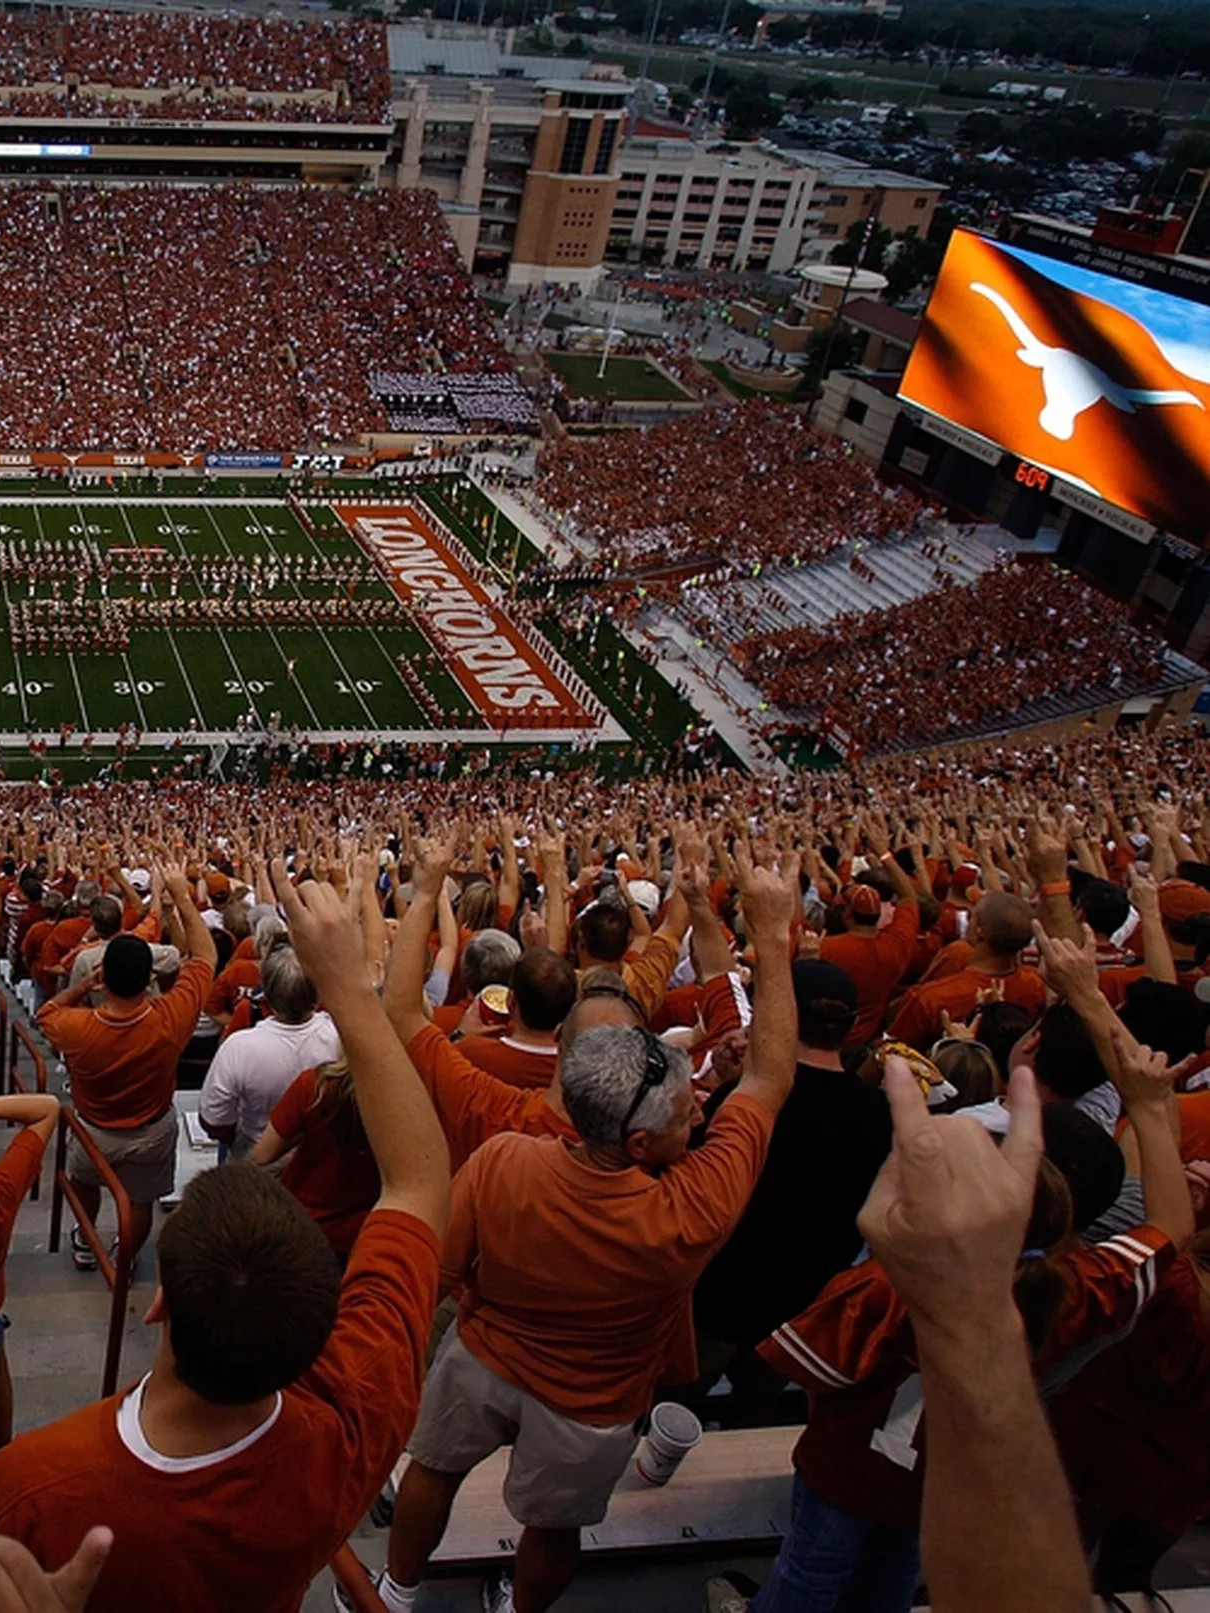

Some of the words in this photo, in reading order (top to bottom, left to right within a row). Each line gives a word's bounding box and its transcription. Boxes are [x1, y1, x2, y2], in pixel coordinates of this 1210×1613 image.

[355, 515, 561, 708] LONGHORNS
[1, 681, 42, 696] 40
[113, 681, 155, 695] 30
[224, 680, 265, 695] 20
[334, 680, 374, 694] 10
